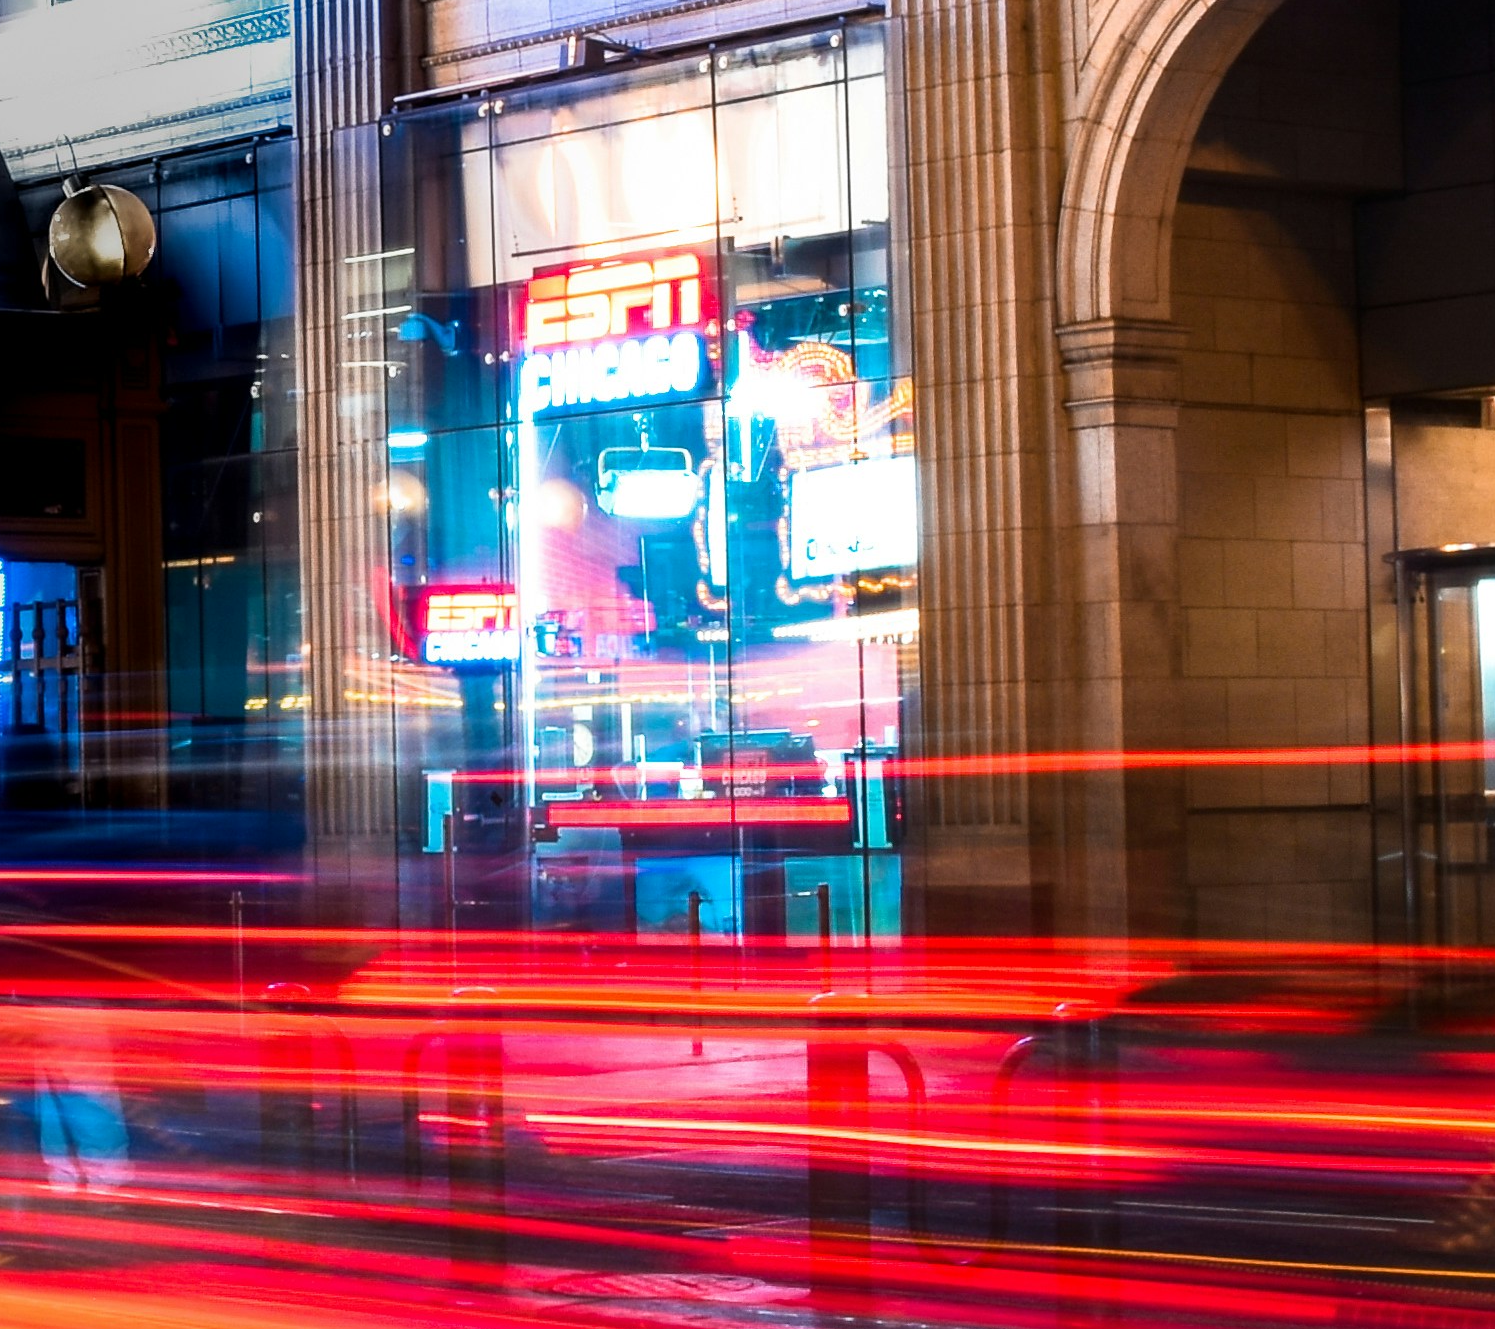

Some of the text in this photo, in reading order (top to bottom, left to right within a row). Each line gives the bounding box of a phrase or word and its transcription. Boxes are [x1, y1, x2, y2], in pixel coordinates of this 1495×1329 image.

[527, 253, 700, 346] ESPN
[519, 332, 700, 412] CHICAGO
[427, 594, 518, 631] ESPN
